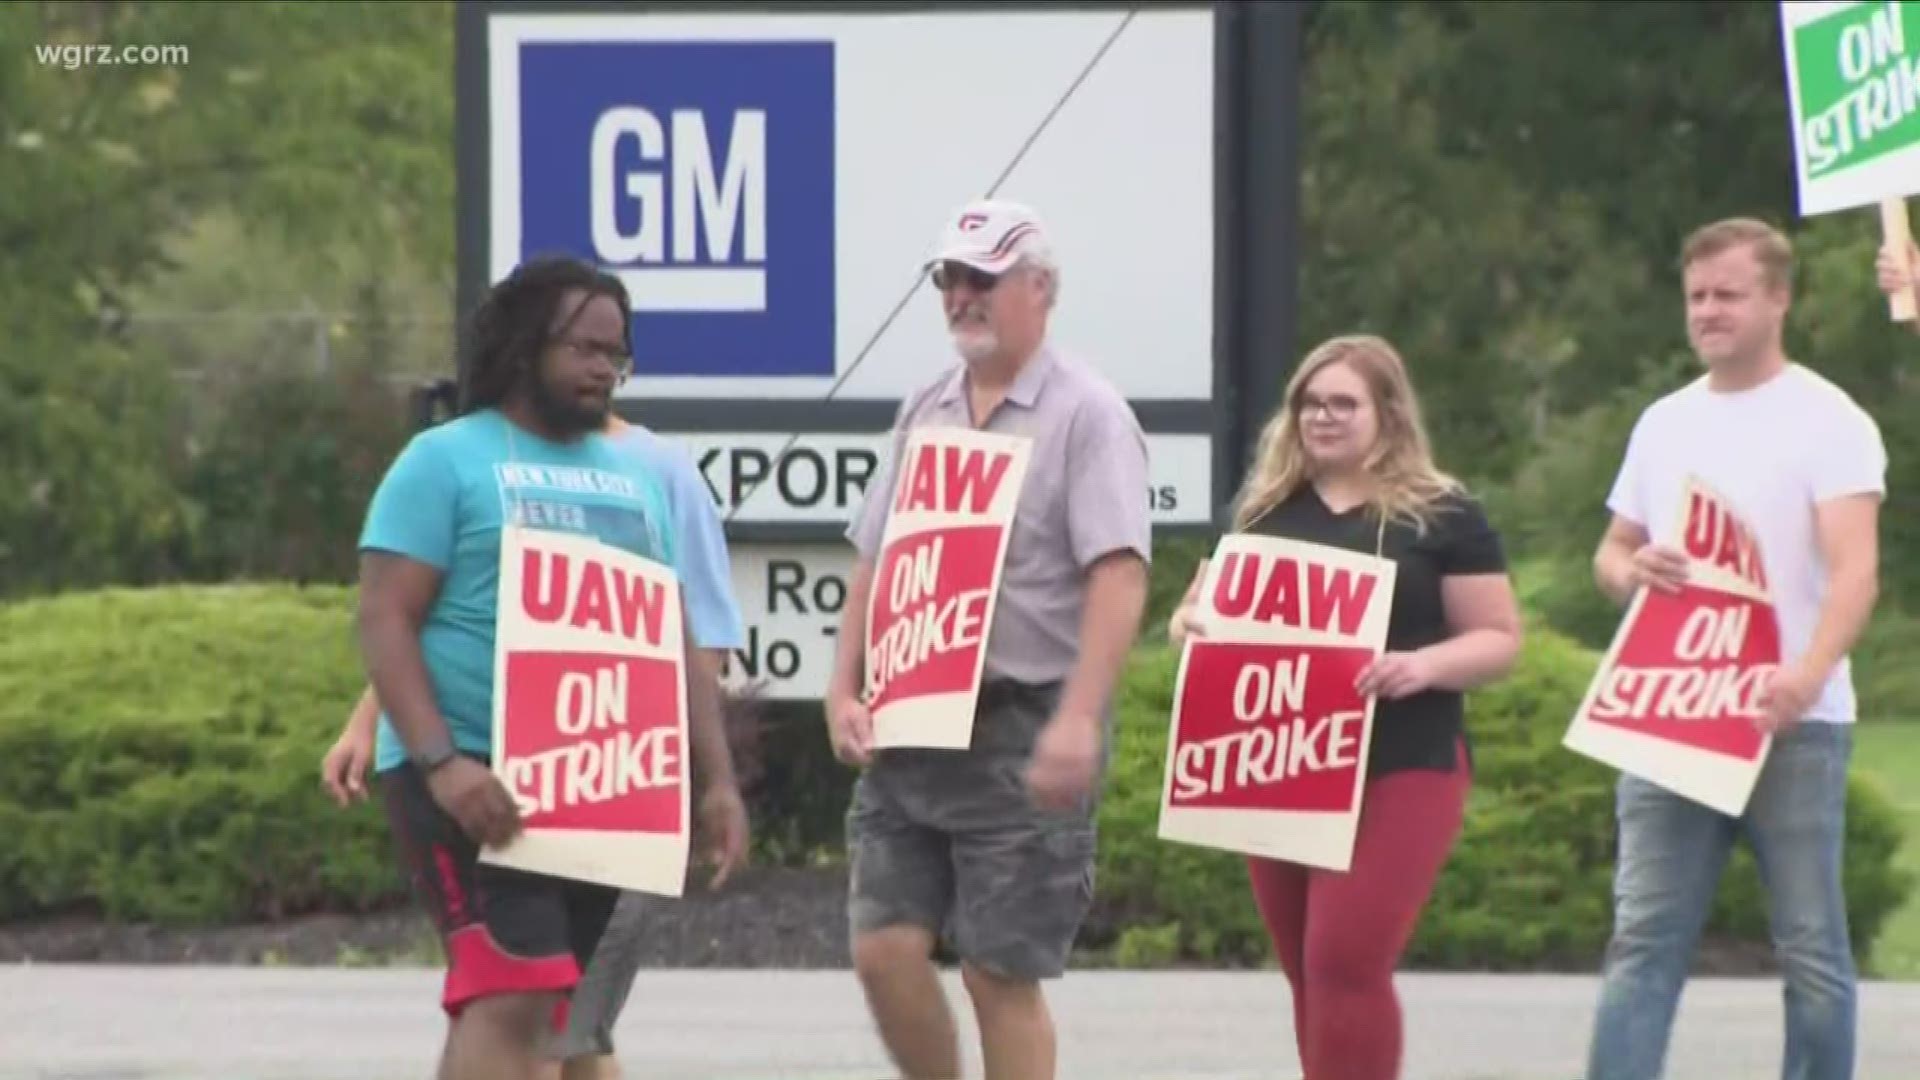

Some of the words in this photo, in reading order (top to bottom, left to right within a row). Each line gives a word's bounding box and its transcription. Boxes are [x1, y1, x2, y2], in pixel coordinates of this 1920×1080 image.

[1838, 1, 1904, 82] ON
[590, 106, 766, 264] GM
[521, 547, 665, 647] UAW
[890, 534, 944, 614] ON
[1212, 552, 1378, 637] UAW
[1673, 604, 1751, 661] ON
[555, 661, 629, 736] ON
[1233, 653, 1310, 723] ON
[506, 726, 680, 818] STRIKE
[1173, 710, 1364, 800] STRIKE
